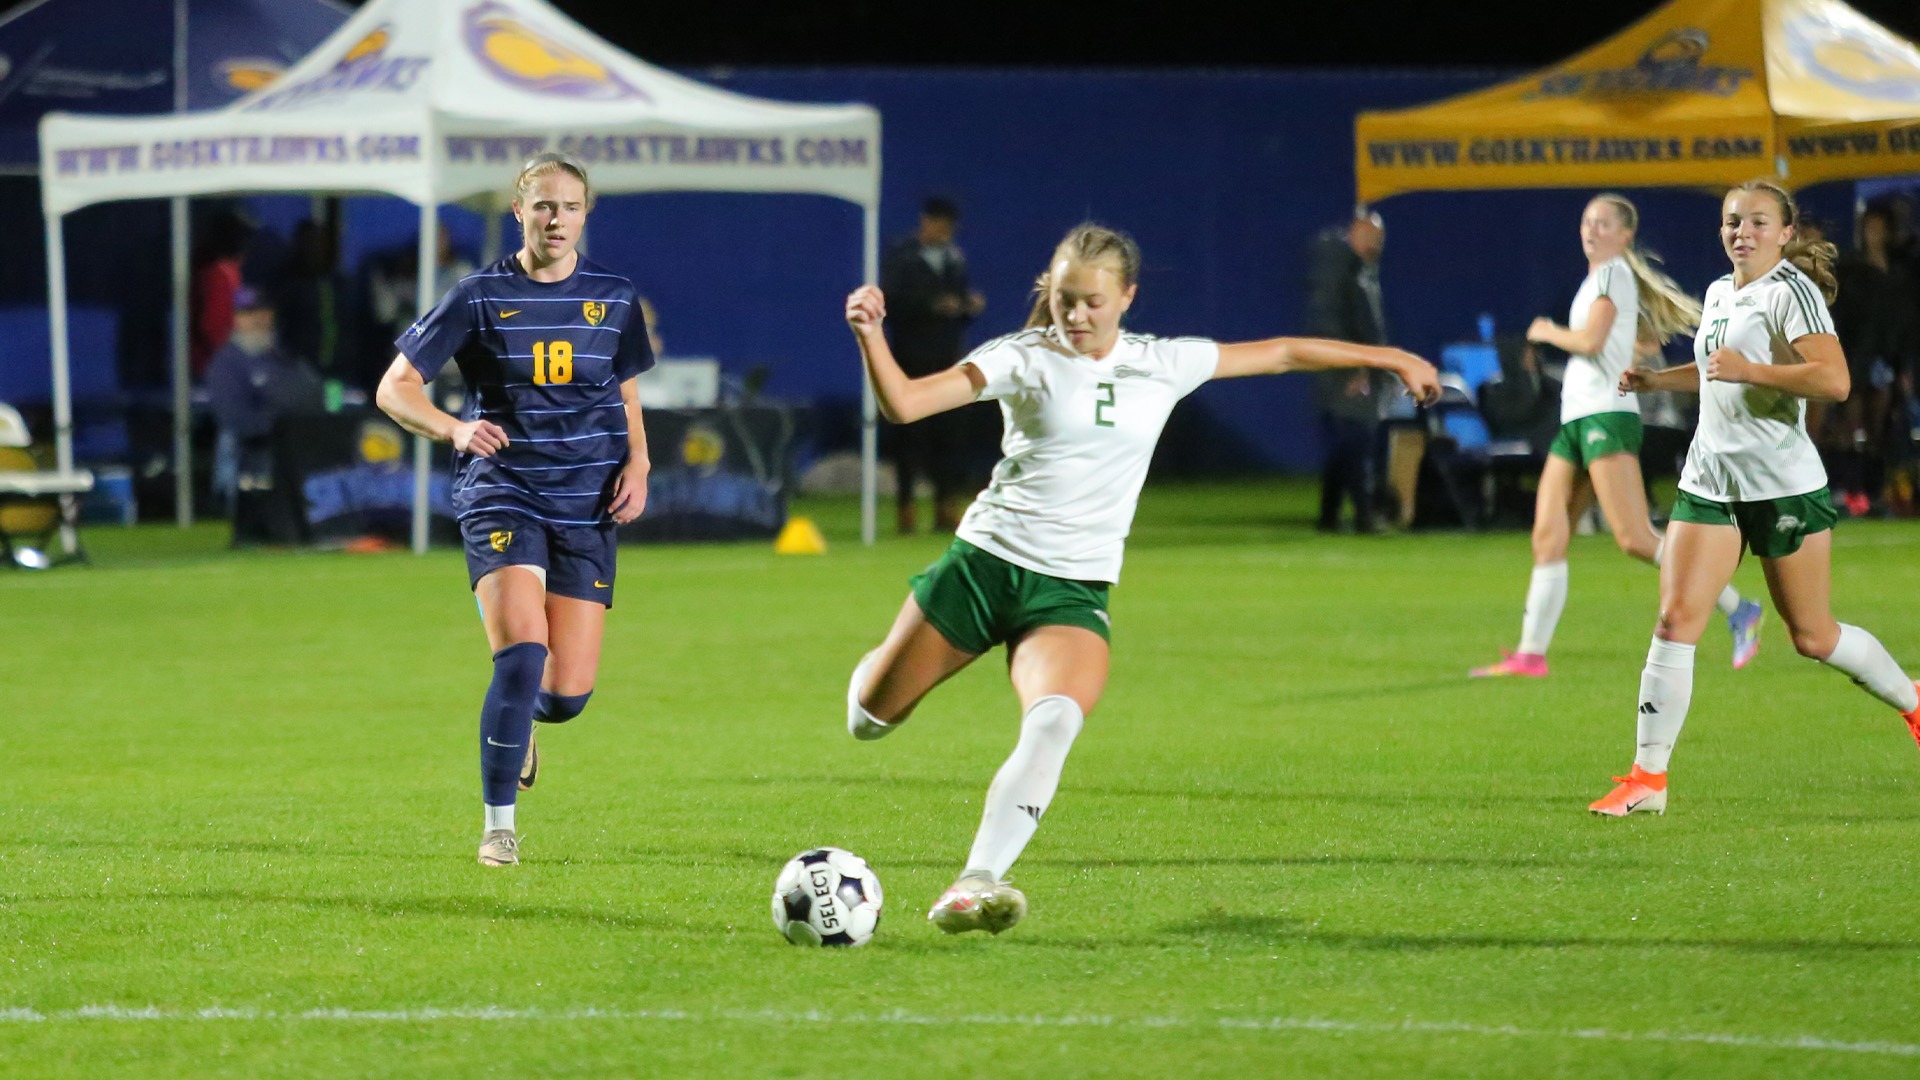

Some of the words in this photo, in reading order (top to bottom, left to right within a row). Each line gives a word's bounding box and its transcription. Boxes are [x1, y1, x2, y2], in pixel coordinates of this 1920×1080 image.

[56, 134, 421, 177] WWW.GOSKYHAWKS.COM
[445, 134, 868, 166] WWWGOSKYHAWKS.COM
[1367, 135, 1764, 168] WWW.GOSKYHAWKS.COM
[1705, 317, 1730, 357] 20
[531, 340, 574, 386] 18
[1094, 382, 1116, 428] 2
[810, 868, 840, 930] SELECT
